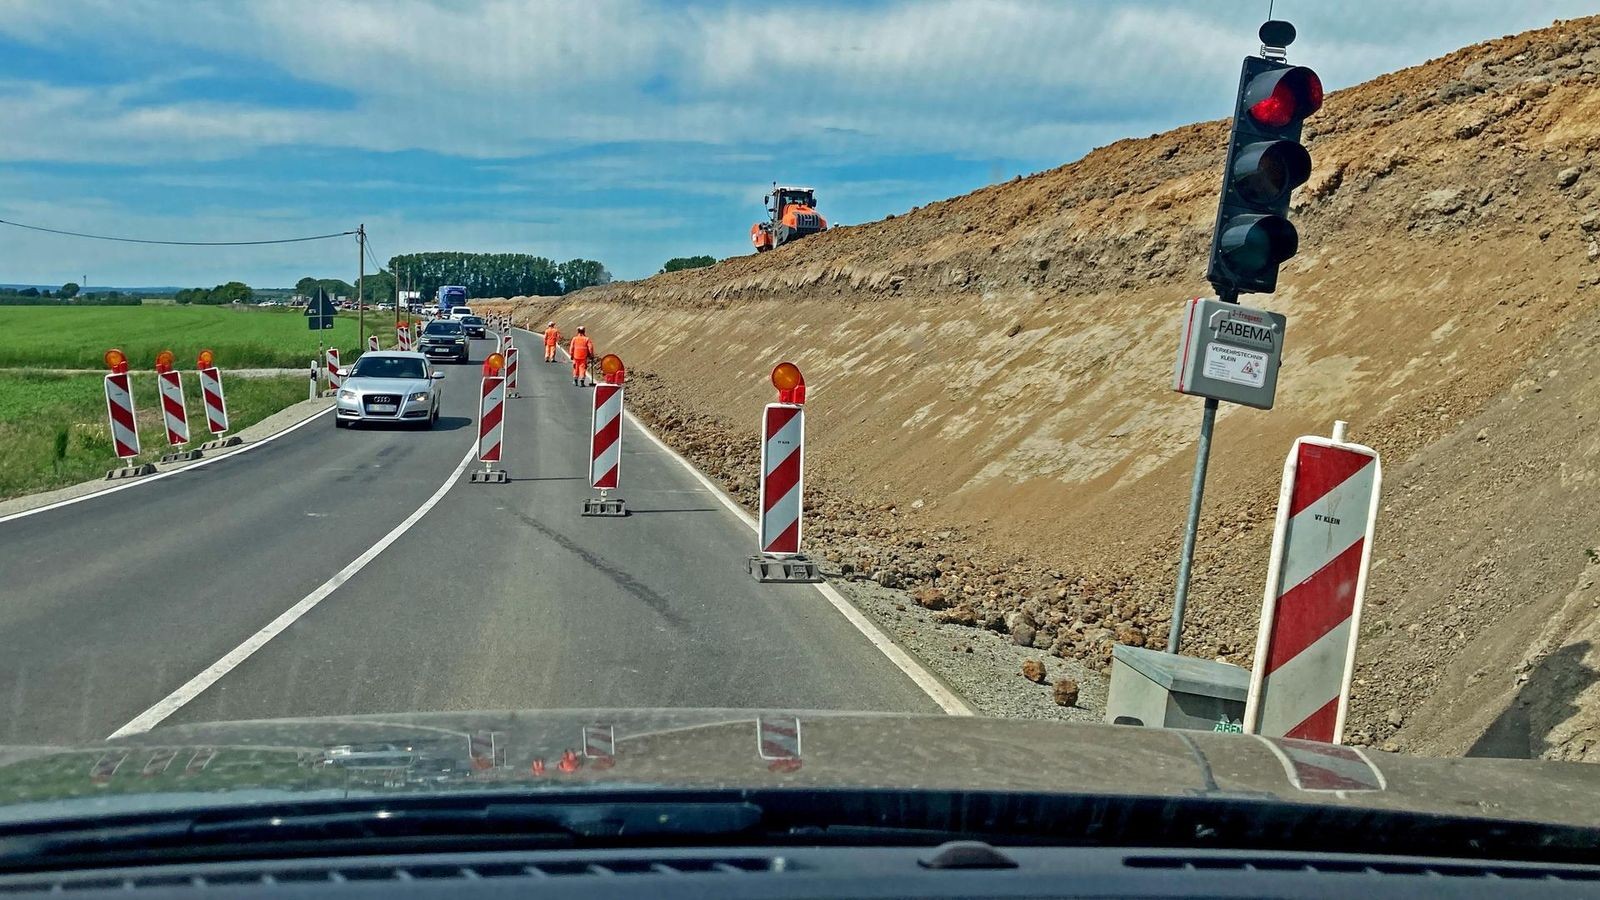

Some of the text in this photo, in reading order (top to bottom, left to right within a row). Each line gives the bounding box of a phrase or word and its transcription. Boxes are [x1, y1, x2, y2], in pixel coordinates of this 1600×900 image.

[1219, 320, 1272, 343] FABEMA
[1211, 346, 1263, 360] VERKEHRSTECHNIK
[1323, 516, 1340, 525] KLEIN
